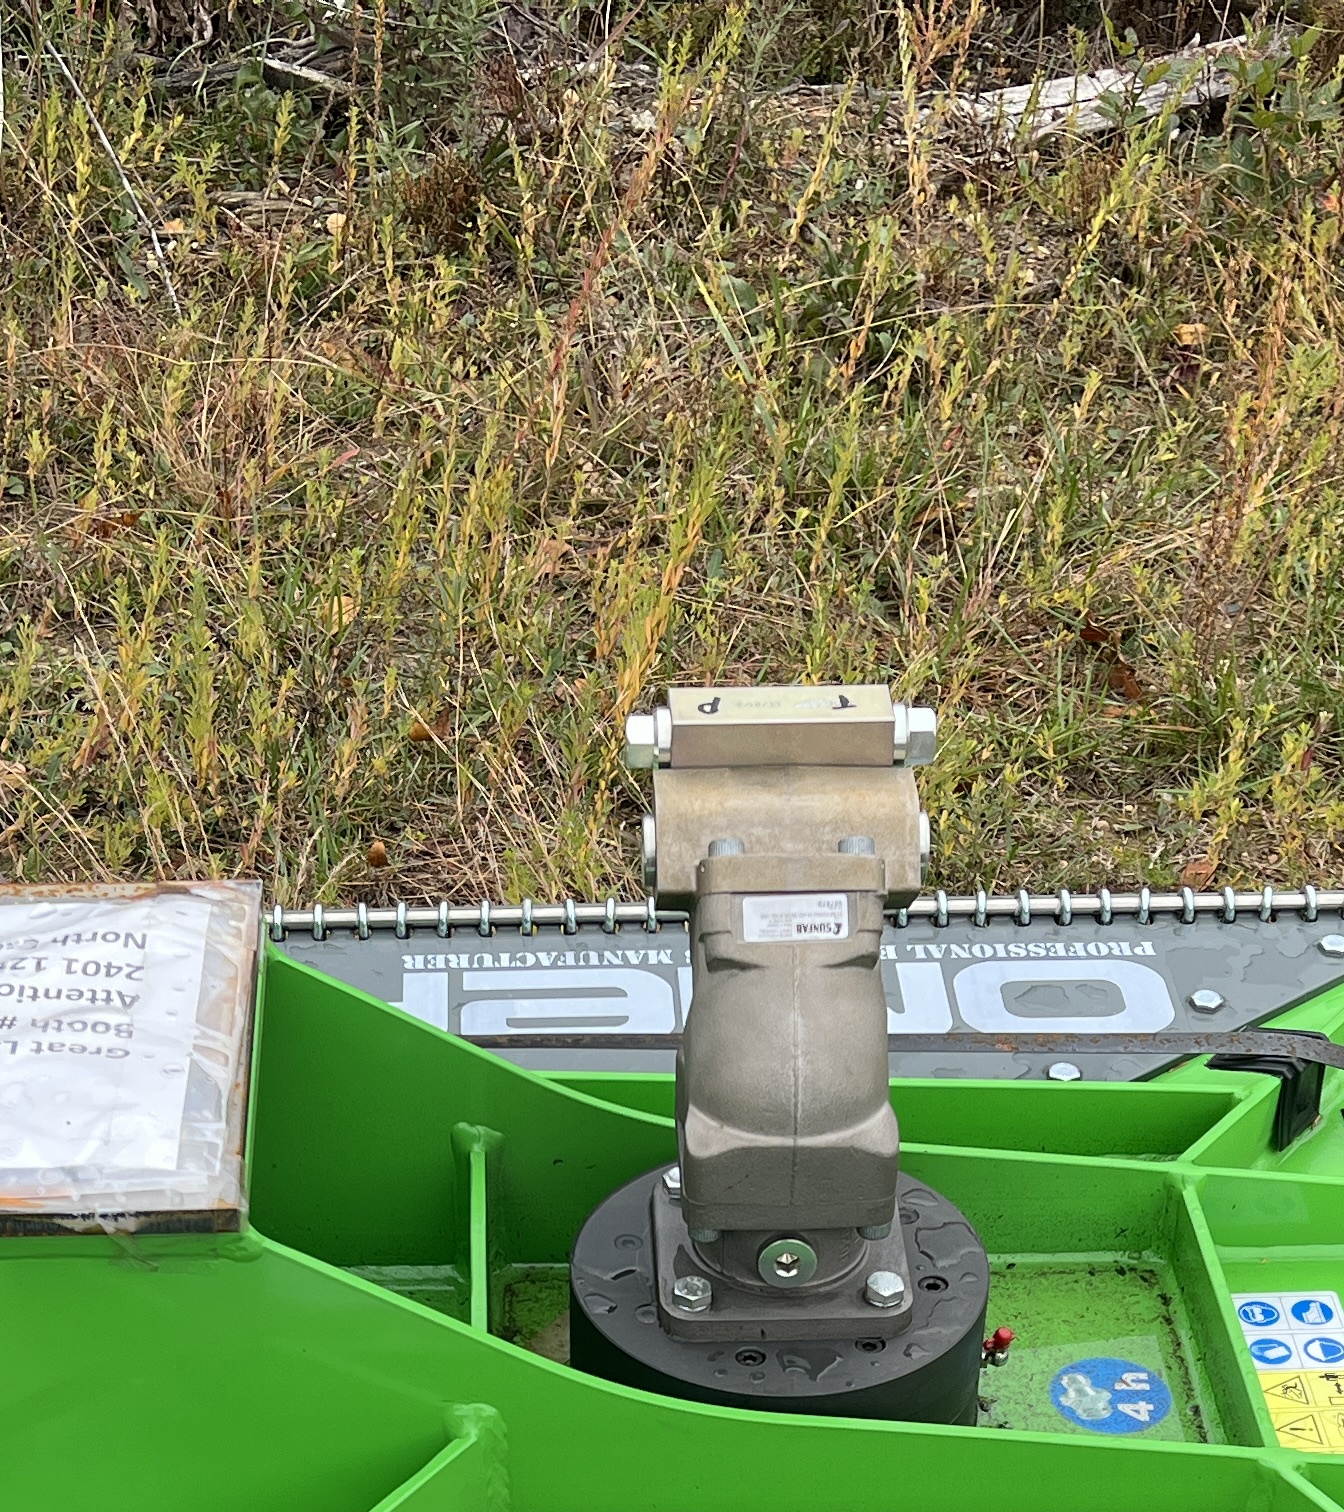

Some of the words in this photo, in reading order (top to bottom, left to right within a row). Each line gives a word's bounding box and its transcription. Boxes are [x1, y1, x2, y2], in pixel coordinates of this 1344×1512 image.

[797, 922, 832, 934] SUNFAB
[51, 930, 147, 950] North
[402, 949, 673, 969] MANUFACTURER
[906, 941, 1157, 960] PROFESSIONAL
[62, 957, 145, 982] 2401
[31, 1018, 135, 1039] Booth
[30, 1040, 131, 1059] Great
[1113, 1373, 1150, 1391] h
[1117, 1401, 1154, 1421] 4
